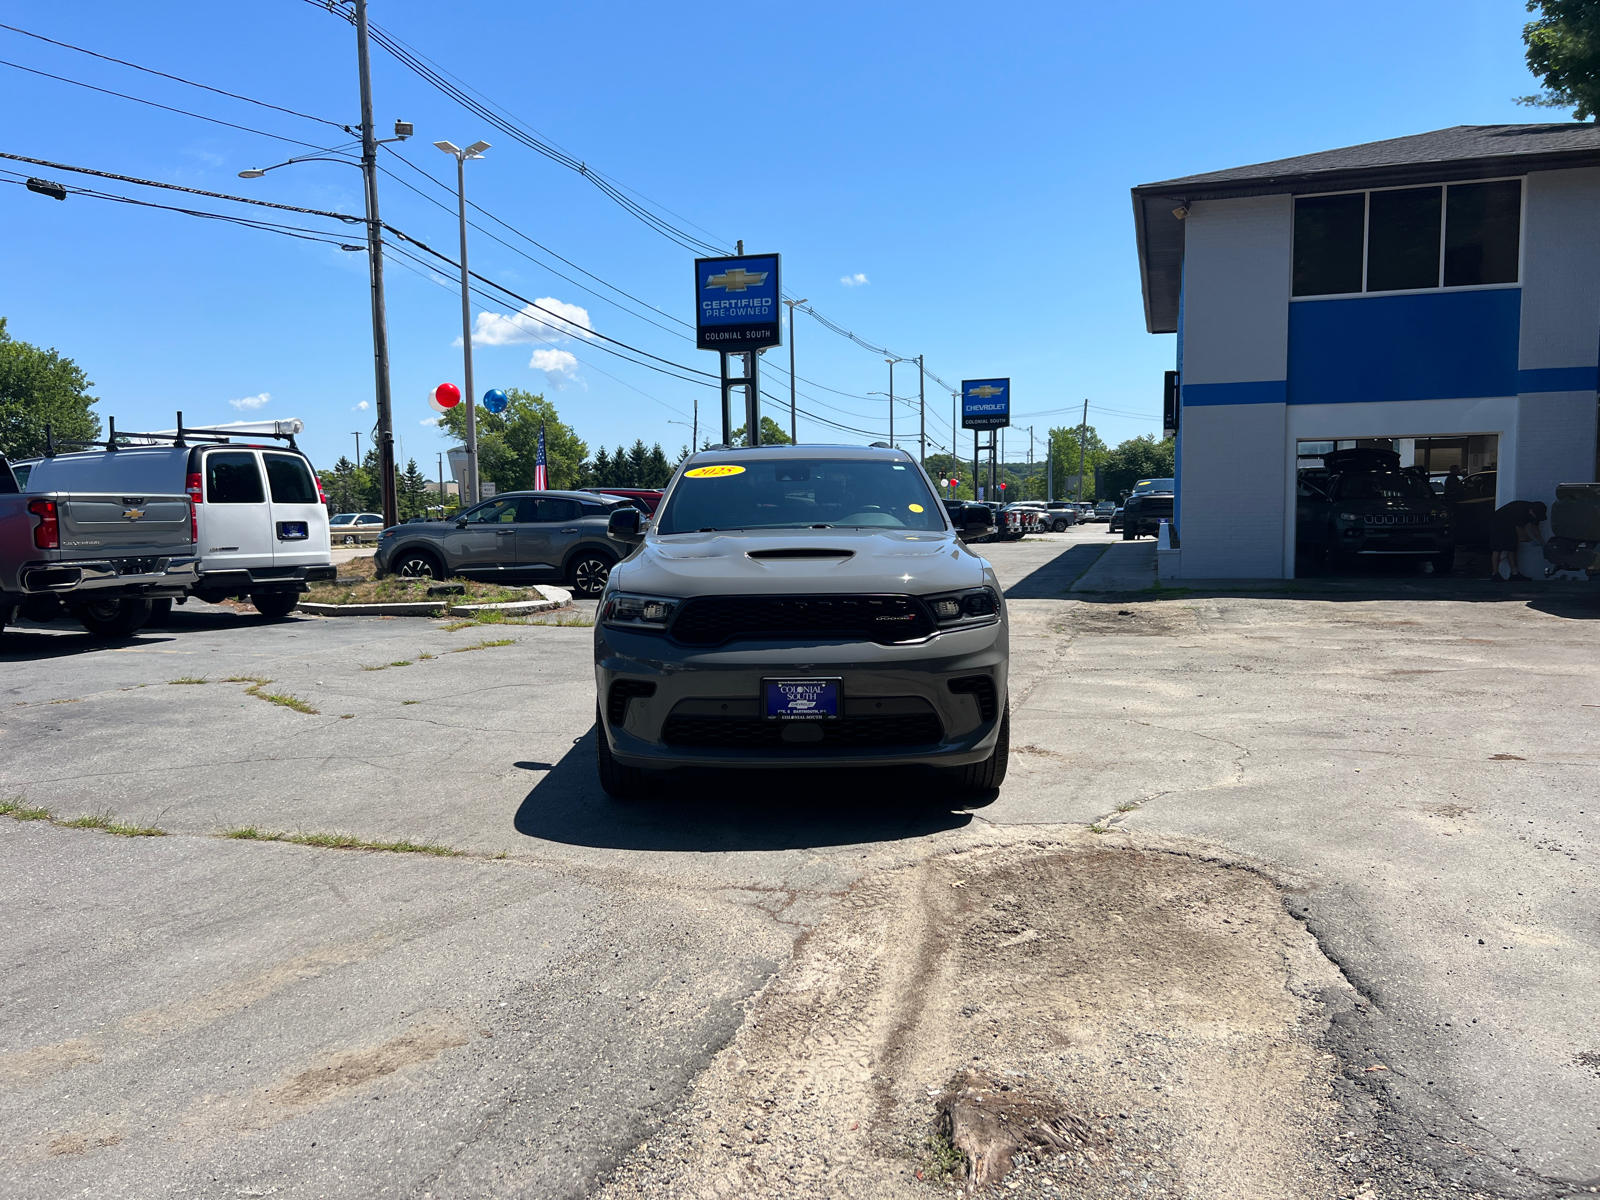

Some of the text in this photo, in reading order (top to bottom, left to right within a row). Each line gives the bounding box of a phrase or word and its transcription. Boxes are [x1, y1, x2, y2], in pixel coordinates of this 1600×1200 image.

[702, 297, 772, 309] CERTIFIED
[706, 306, 769, 317] PRE-OWNED
[705, 330, 771, 340] COLONIAL SOUTH
[965, 403, 1006, 412] CHEVROLET
[693, 466, 736, 477] 2025
[780, 686, 823, 694] COLONIAL
[787, 693, 817, 701] SOUTH
